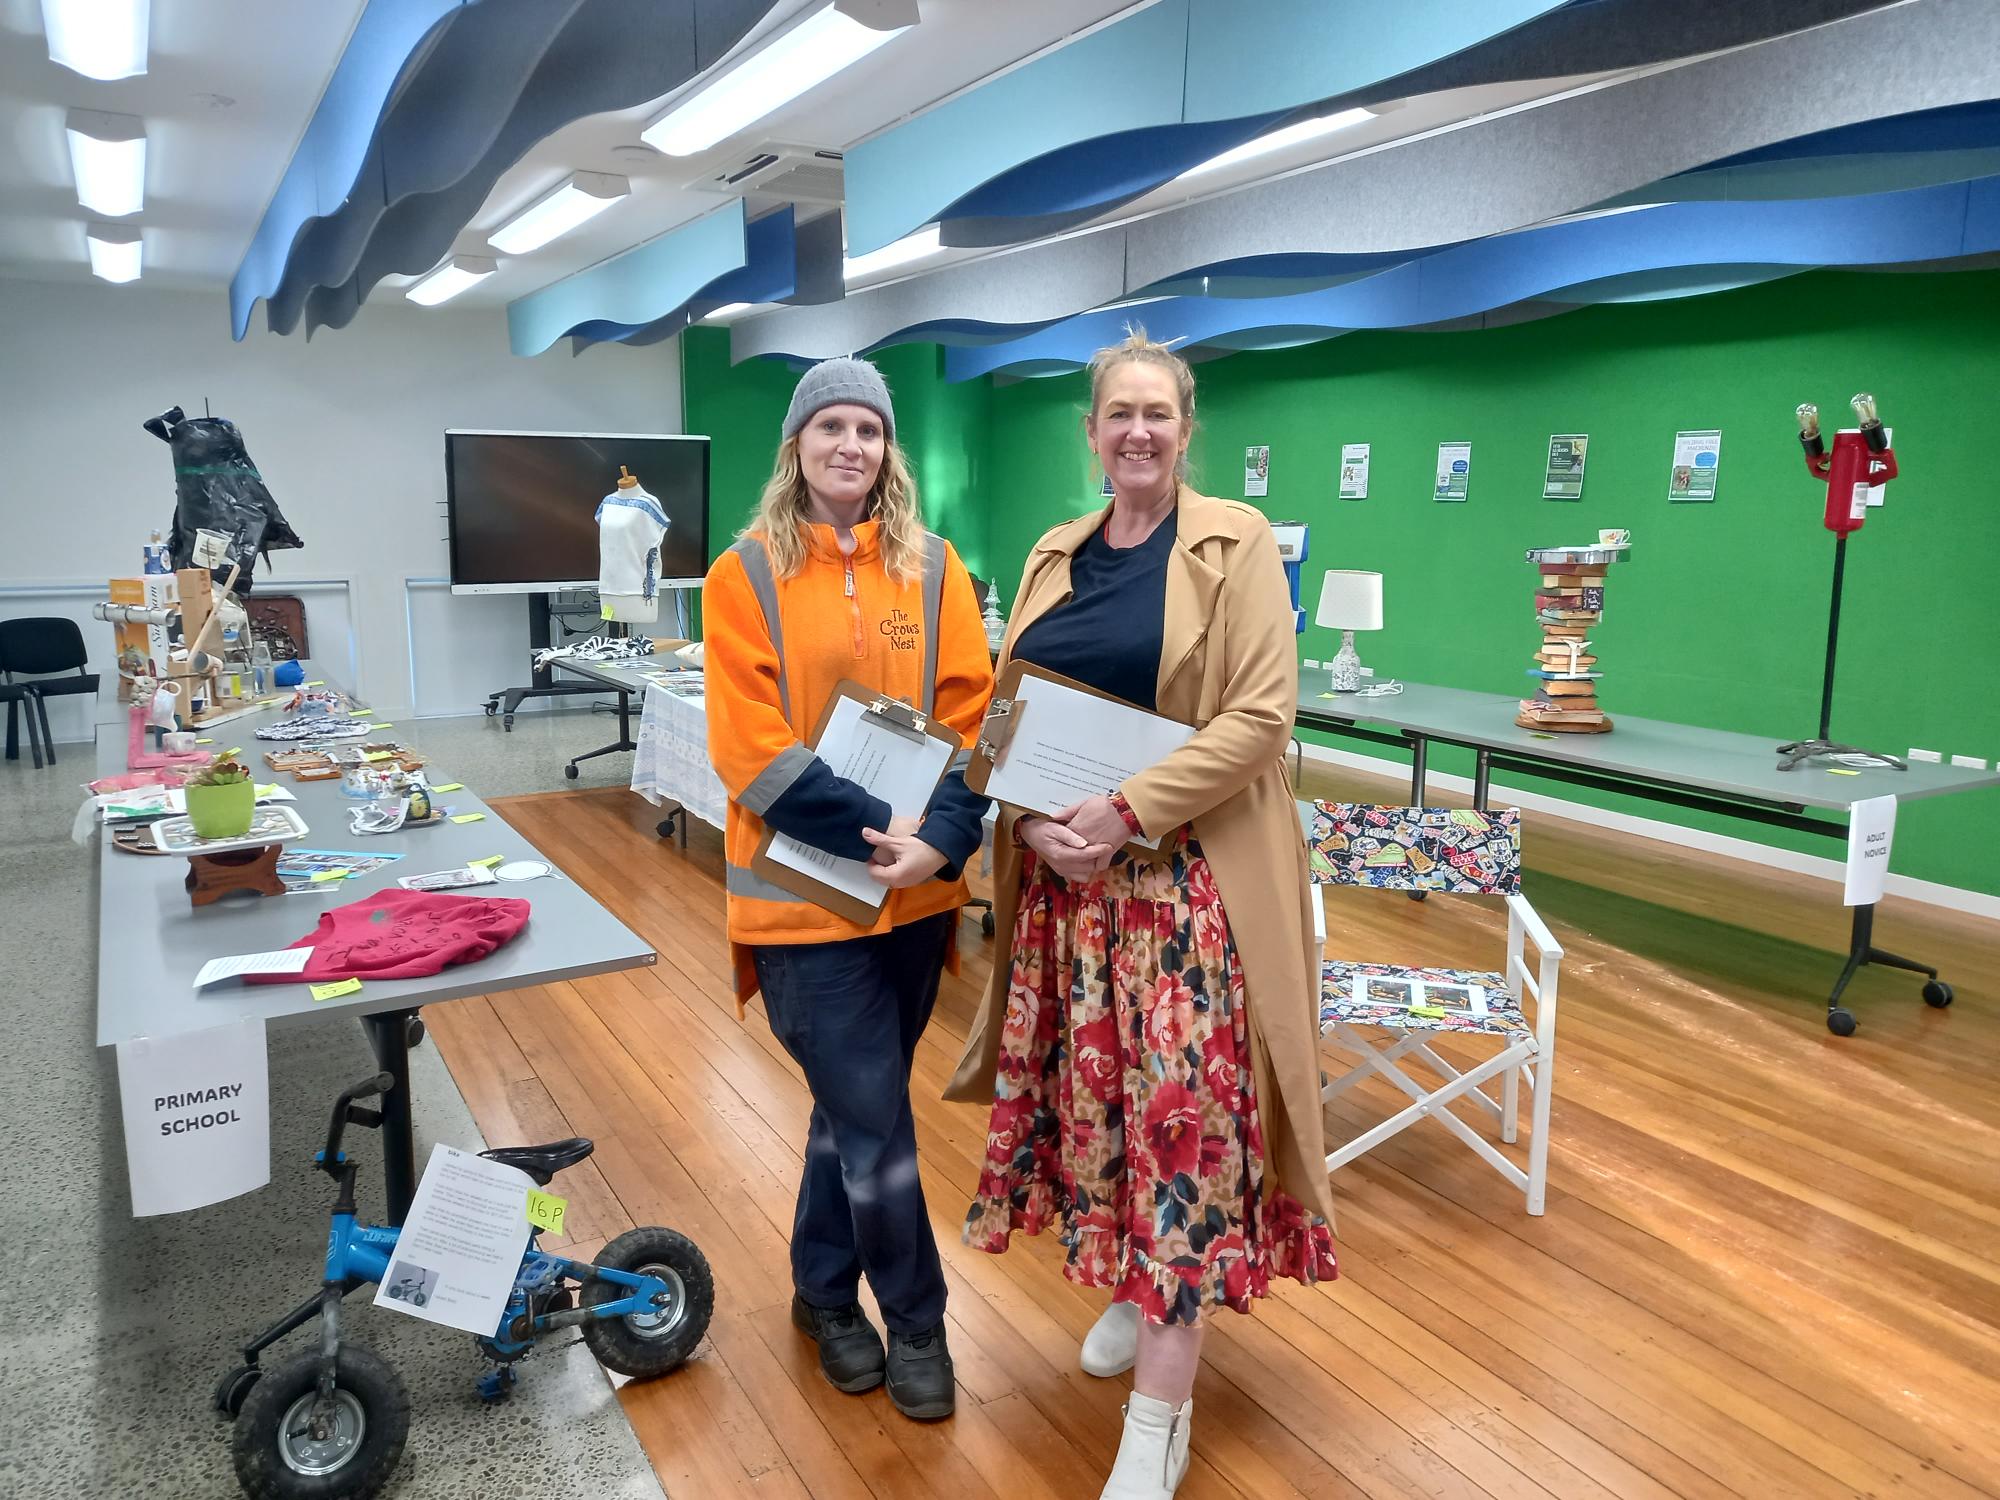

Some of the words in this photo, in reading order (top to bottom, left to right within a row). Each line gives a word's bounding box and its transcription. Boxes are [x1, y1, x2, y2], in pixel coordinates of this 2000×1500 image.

[891, 609, 908, 622] The
[880, 619, 919, 636] Crows
[891, 636, 916, 650] Nest
[1866, 832, 1886, 843] ADULT
[1864, 846, 1887, 859] NOVICE
[155, 1083, 242, 1111] PRIMARY
[161, 1109, 240, 1136] SCHOOL
